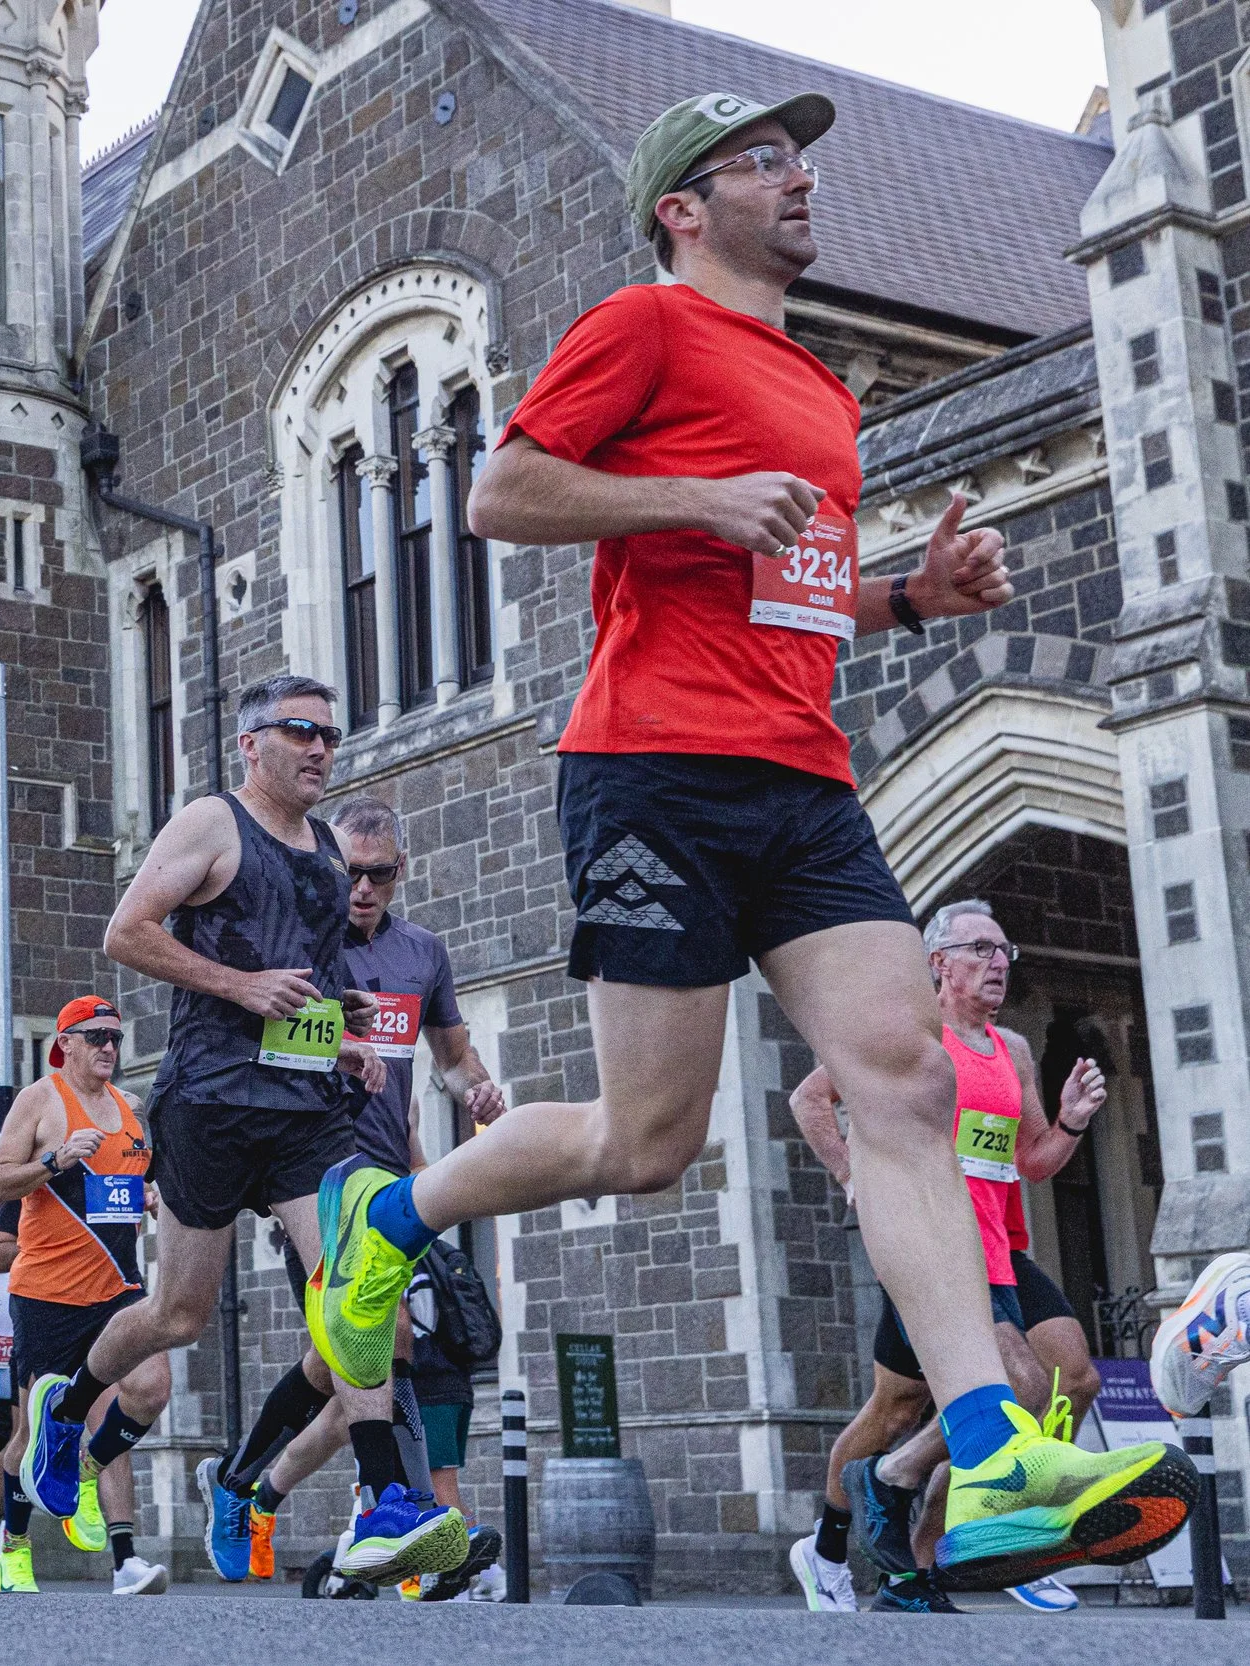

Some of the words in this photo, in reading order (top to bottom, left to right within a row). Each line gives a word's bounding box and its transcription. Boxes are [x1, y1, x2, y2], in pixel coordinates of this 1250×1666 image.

[781, 545, 853, 594] 3234
[808, 594, 834, 607] ADAM
[797, 613, 812, 622] Half
[813, 616, 842, 629] Marathon
[286, 1016, 335, 1044] 7115
[371, 1011, 409, 1034] 428
[972, 1128, 1010, 1153] 7232
[108, 1188, 130, 1205] 48
